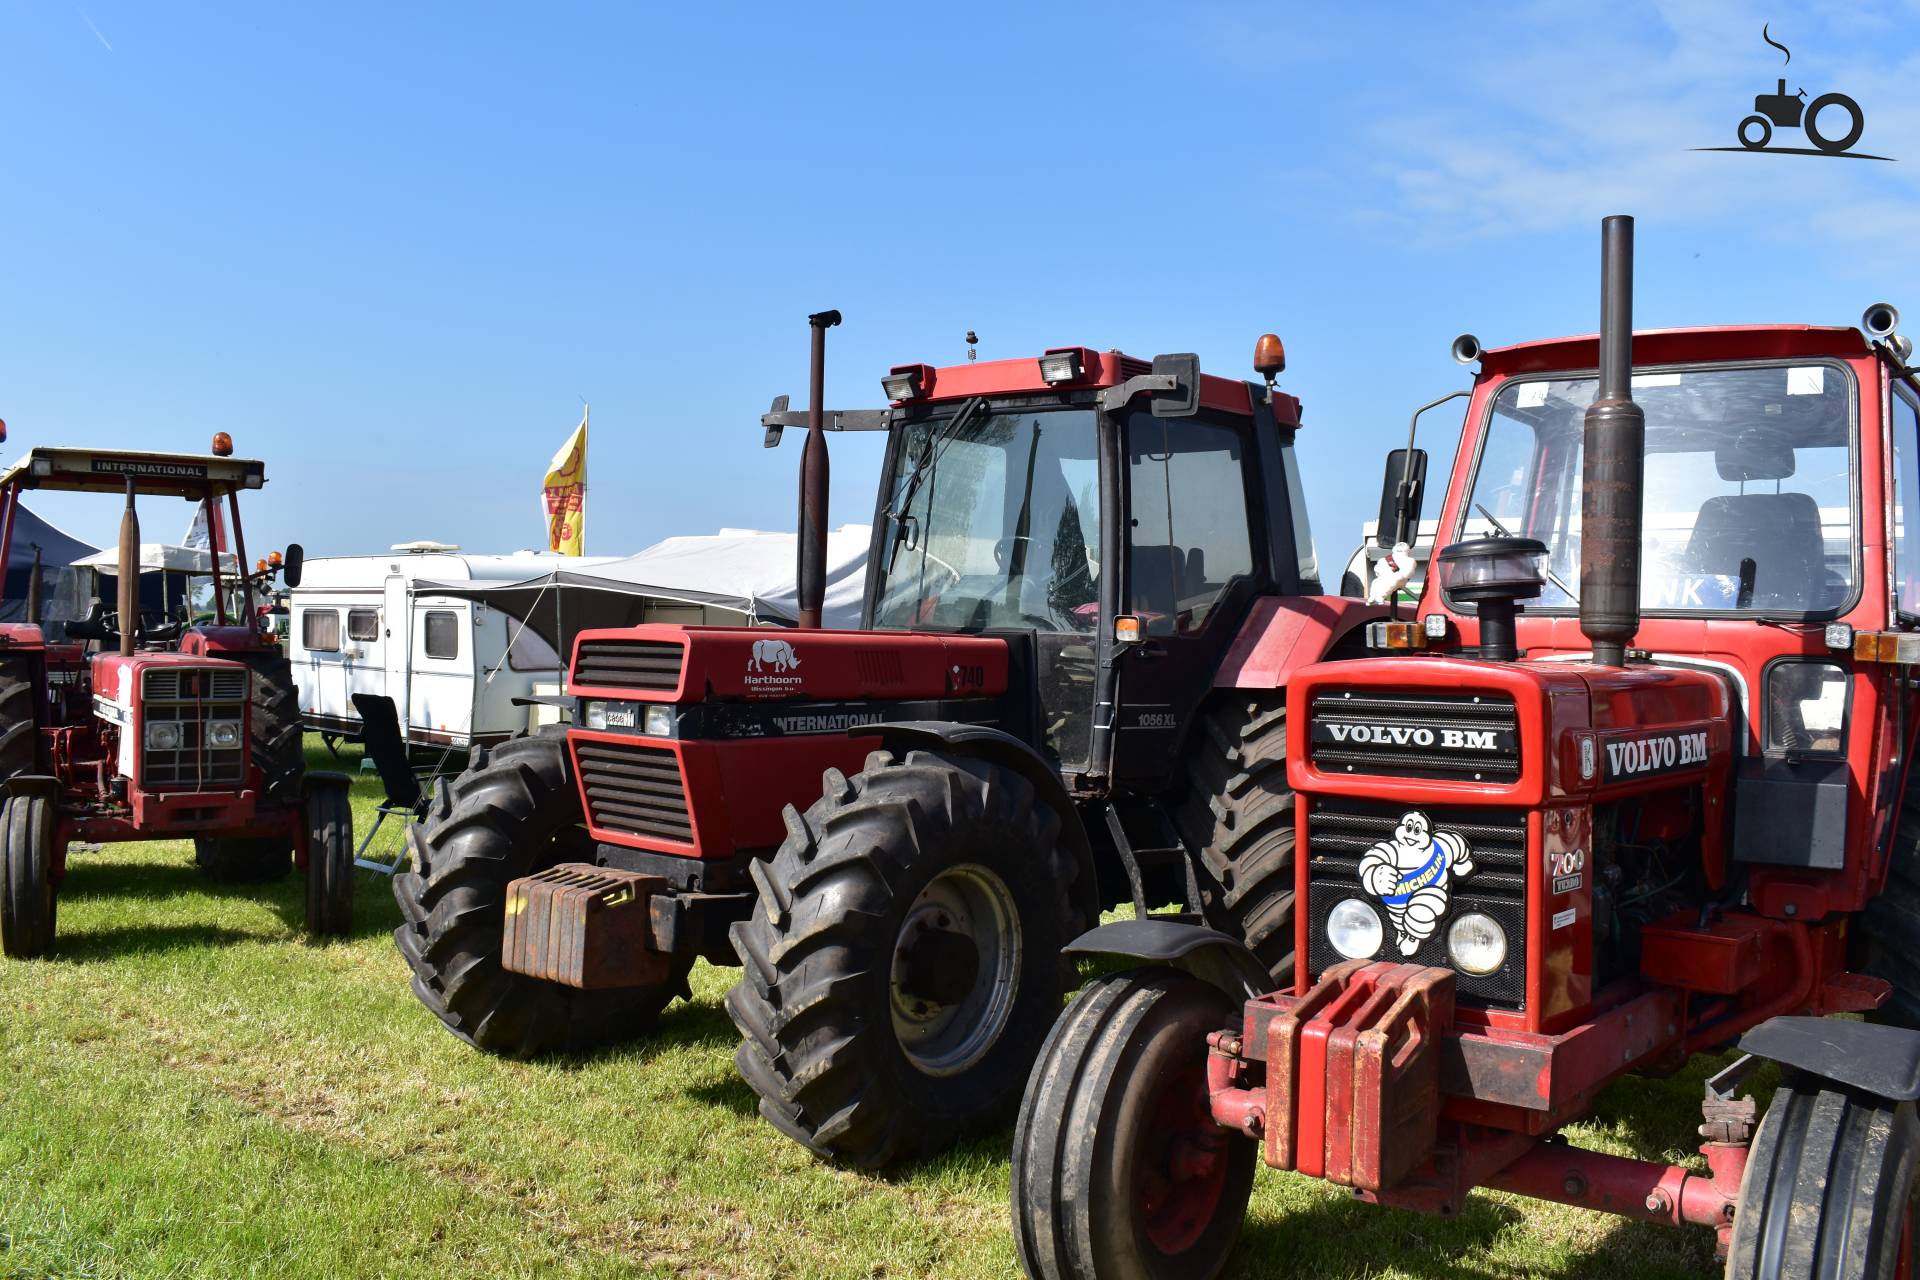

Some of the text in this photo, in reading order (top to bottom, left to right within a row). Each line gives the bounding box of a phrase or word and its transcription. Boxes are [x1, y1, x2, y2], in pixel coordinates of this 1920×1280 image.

[97, 461, 202, 476] INTERNATIONAL
[744, 675, 802, 684] Harthoorn
[1325, 724, 1498, 750] VOLVO BM
[1606, 736, 1676, 776] VOLVO
[1678, 732, 1708, 765] BM
[1395, 852, 1443, 896] MICHELIN
[1551, 848, 1585, 877] 700
